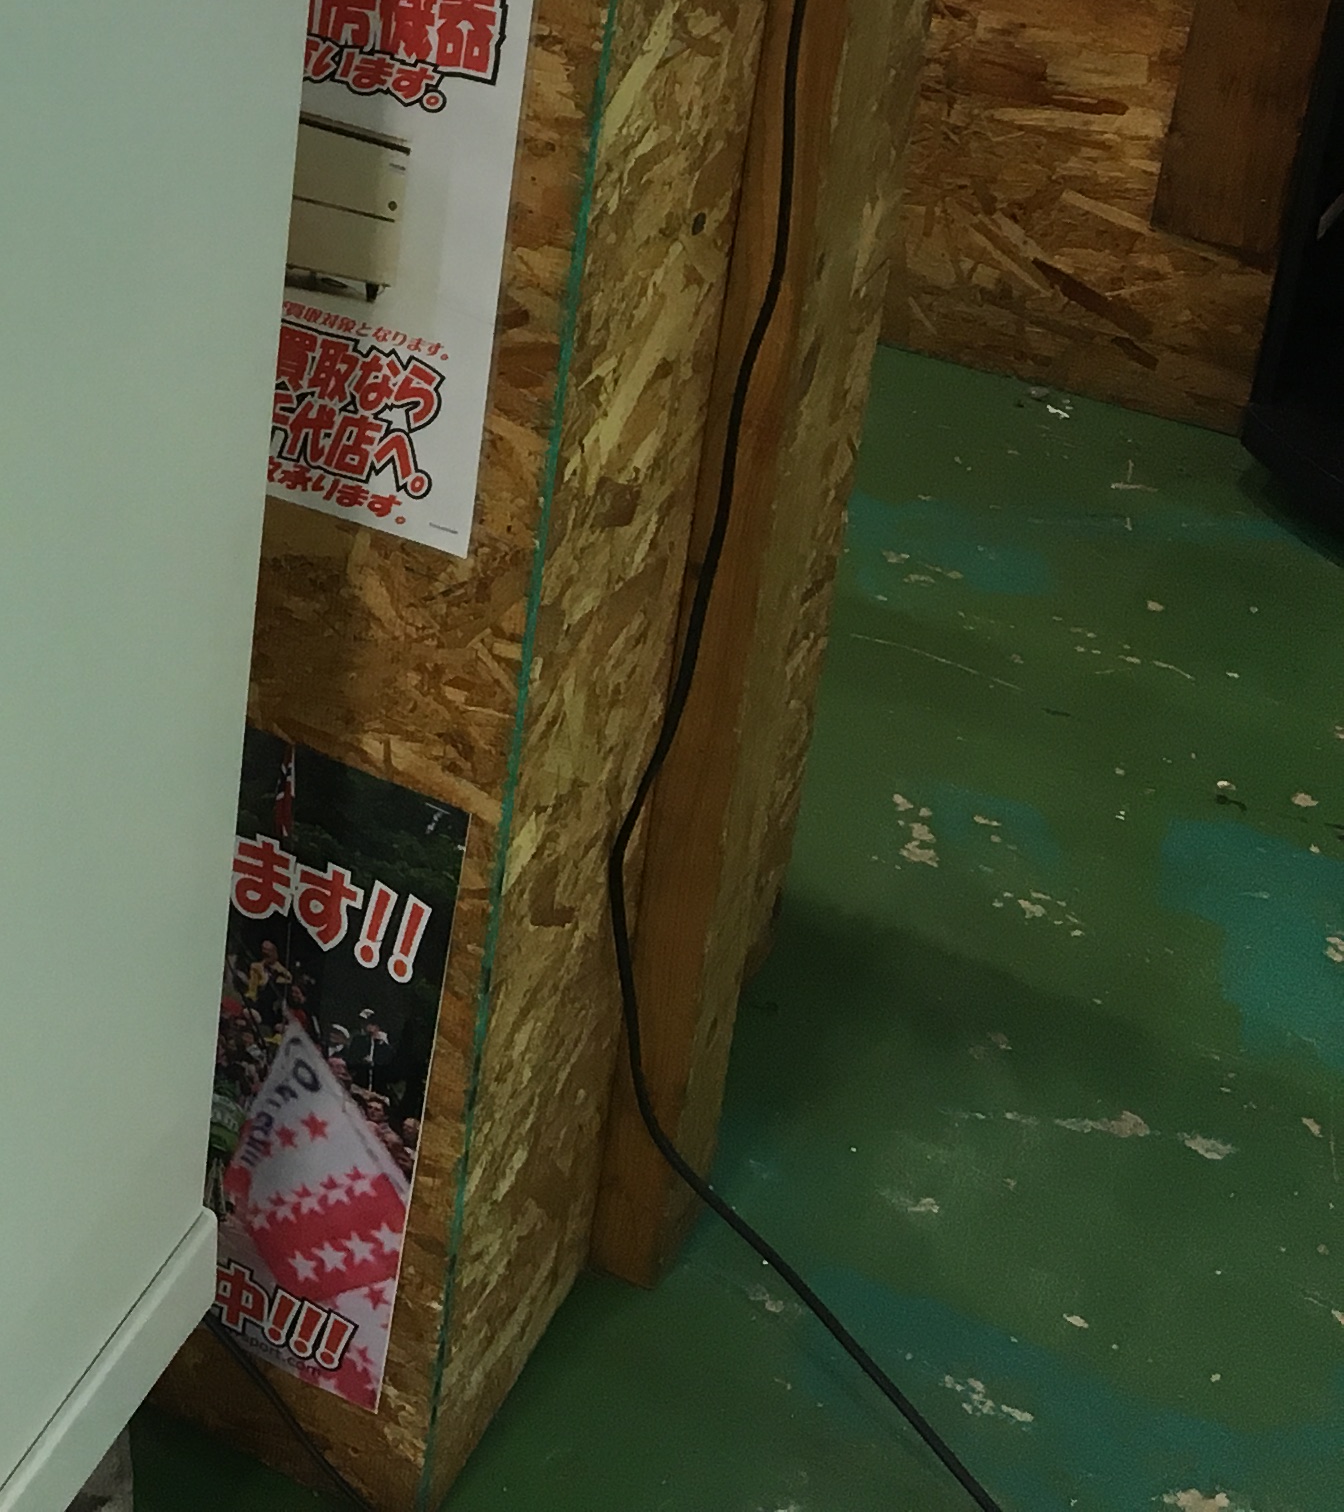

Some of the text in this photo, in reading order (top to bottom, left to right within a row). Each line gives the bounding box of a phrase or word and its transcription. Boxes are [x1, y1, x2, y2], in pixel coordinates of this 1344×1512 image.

[277, 324, 437, 425] 買取なら
[232, 836, 431, 981] ます!!
